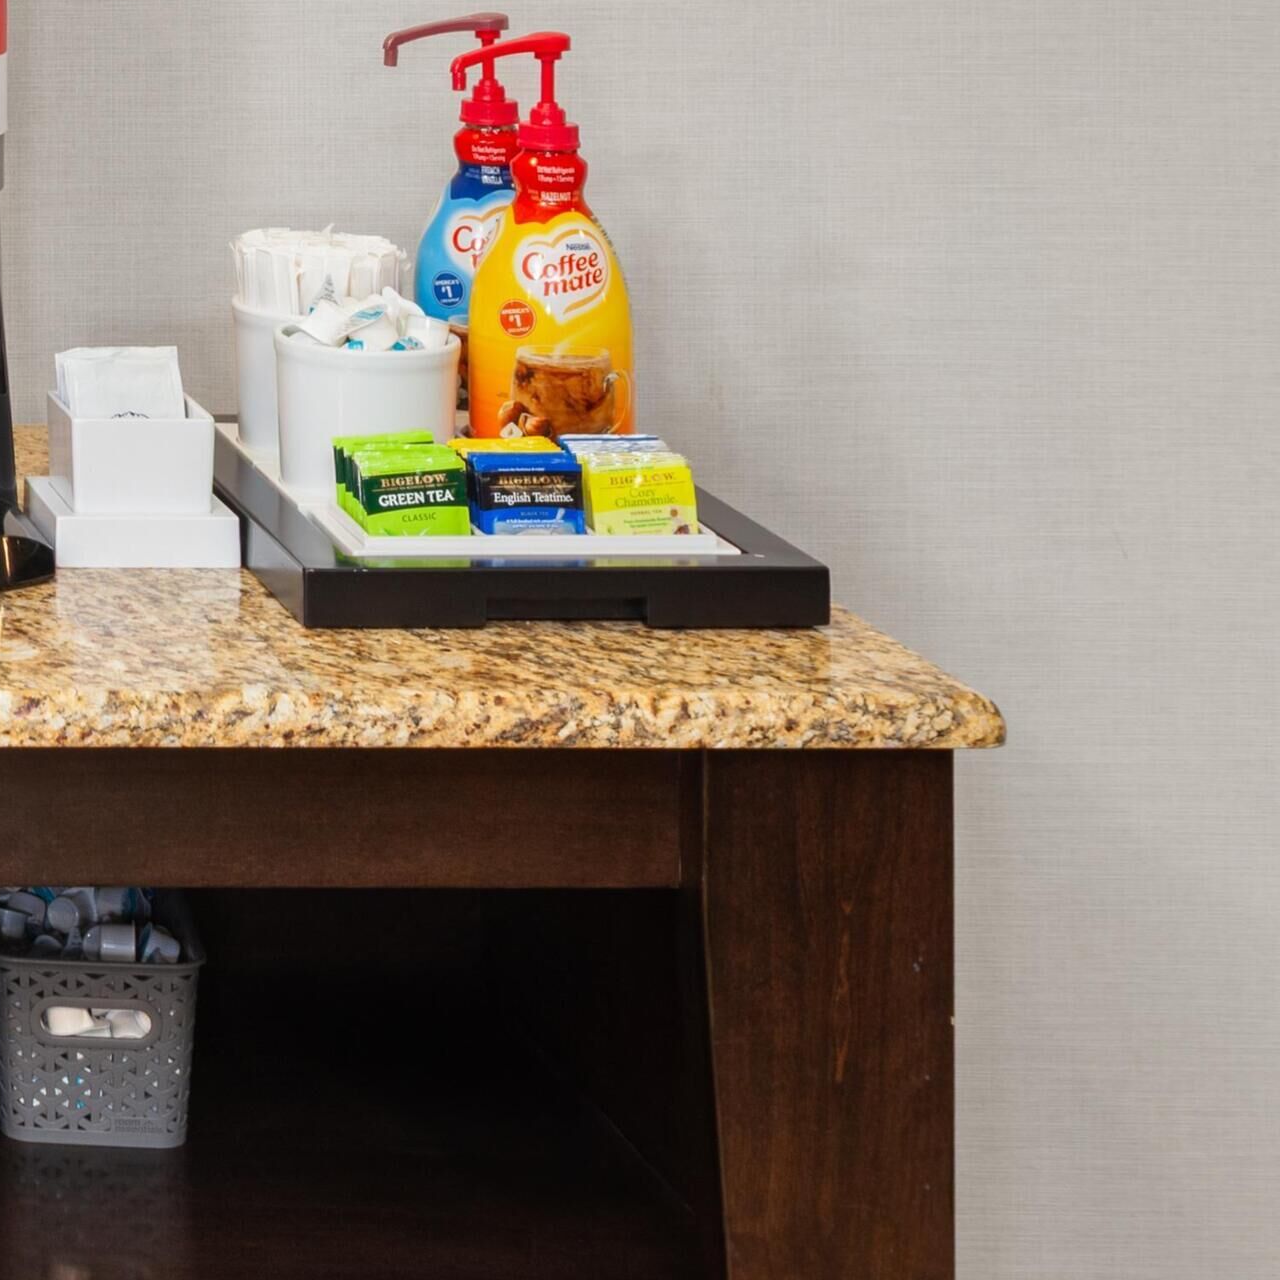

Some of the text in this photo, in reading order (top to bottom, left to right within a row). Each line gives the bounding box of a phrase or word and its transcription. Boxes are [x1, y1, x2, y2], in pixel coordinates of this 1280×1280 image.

[521, 251, 598, 281] Coffee
[543, 266, 604, 297] mate
[610, 472, 675, 485] BIGLOW
[378, 489, 455, 507] GREEN TEA
[493, 492, 531, 506] English
[629, 488, 656, 499] Cozy
[614, 496, 676, 508] Chamomile
[401, 512, 437, 522] CLASSIC
